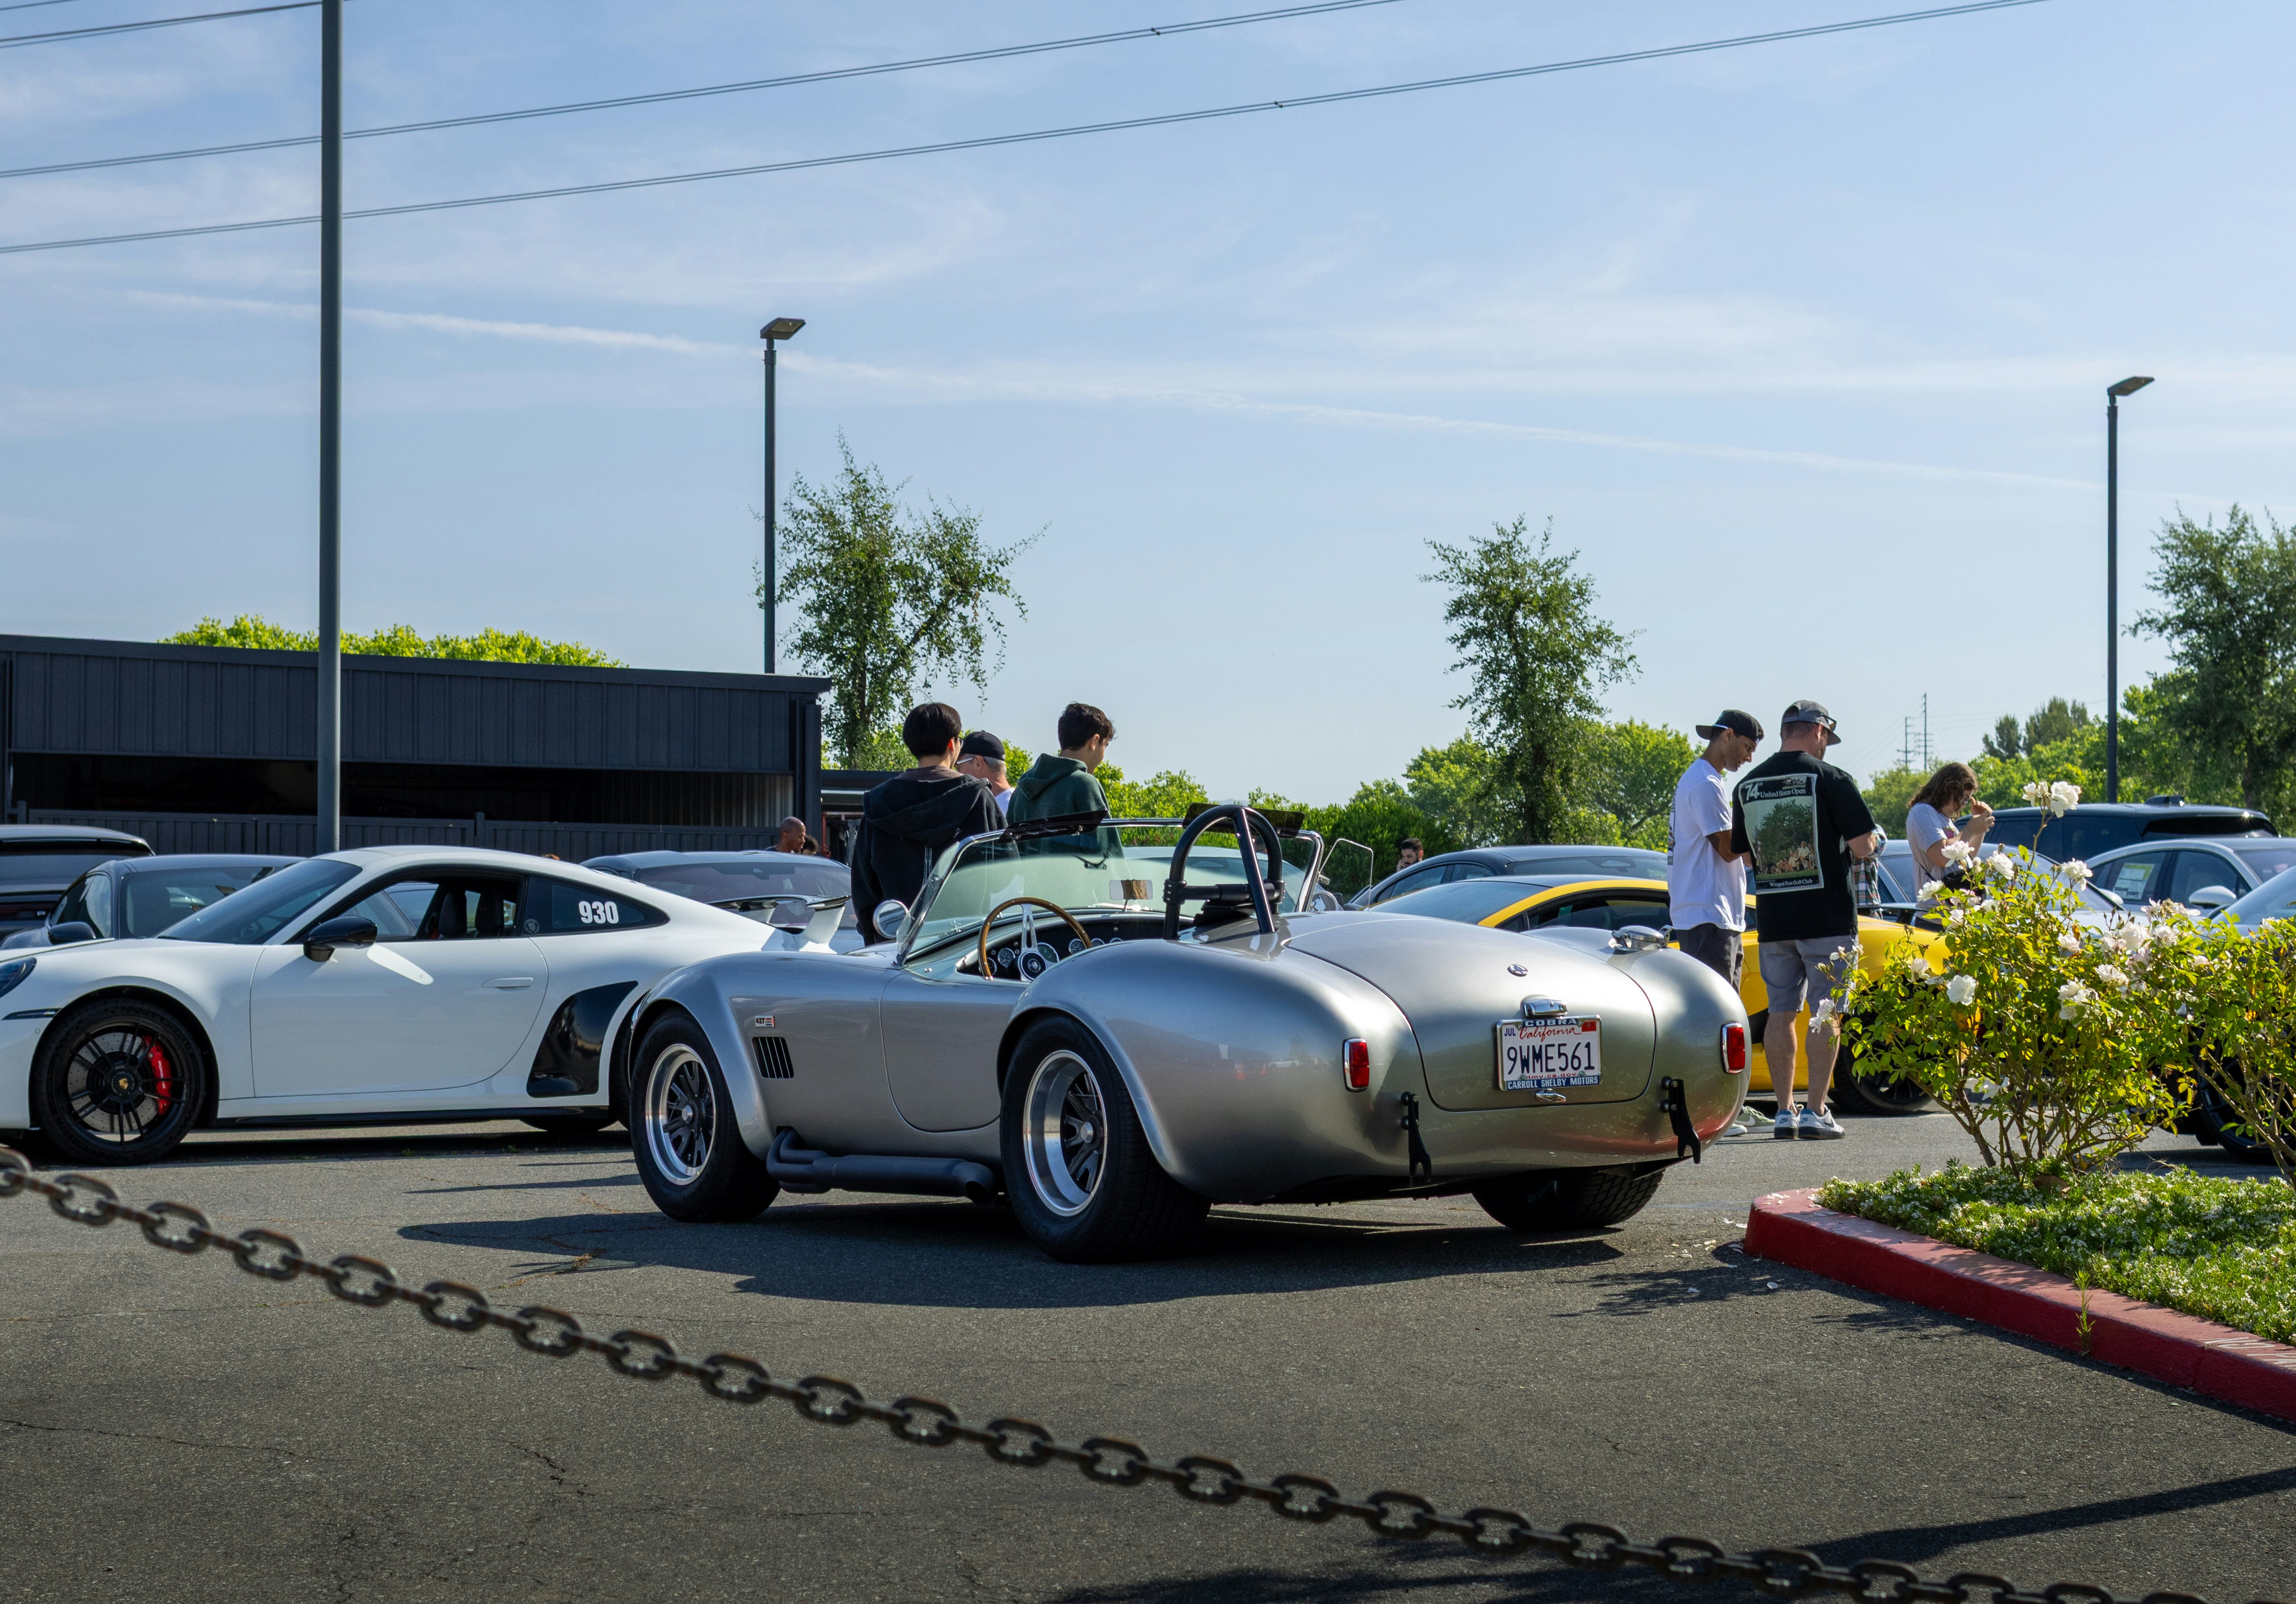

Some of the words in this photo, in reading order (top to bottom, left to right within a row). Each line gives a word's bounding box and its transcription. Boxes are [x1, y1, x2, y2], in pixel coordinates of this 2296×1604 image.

[578, 900, 619, 924] 930
[1525, 1018, 1578, 1027] COBRA
[1504, 1028, 1516, 1037] JUL
[1520, 1026, 1582, 1042] California
[1507, 1042, 1595, 1075] 9WME561
[1507, 1080, 1538, 1090] CARROLL
[1541, 1078, 1566, 1087] SHELBY
[1570, 1076, 1598, 1085] MOTORS
